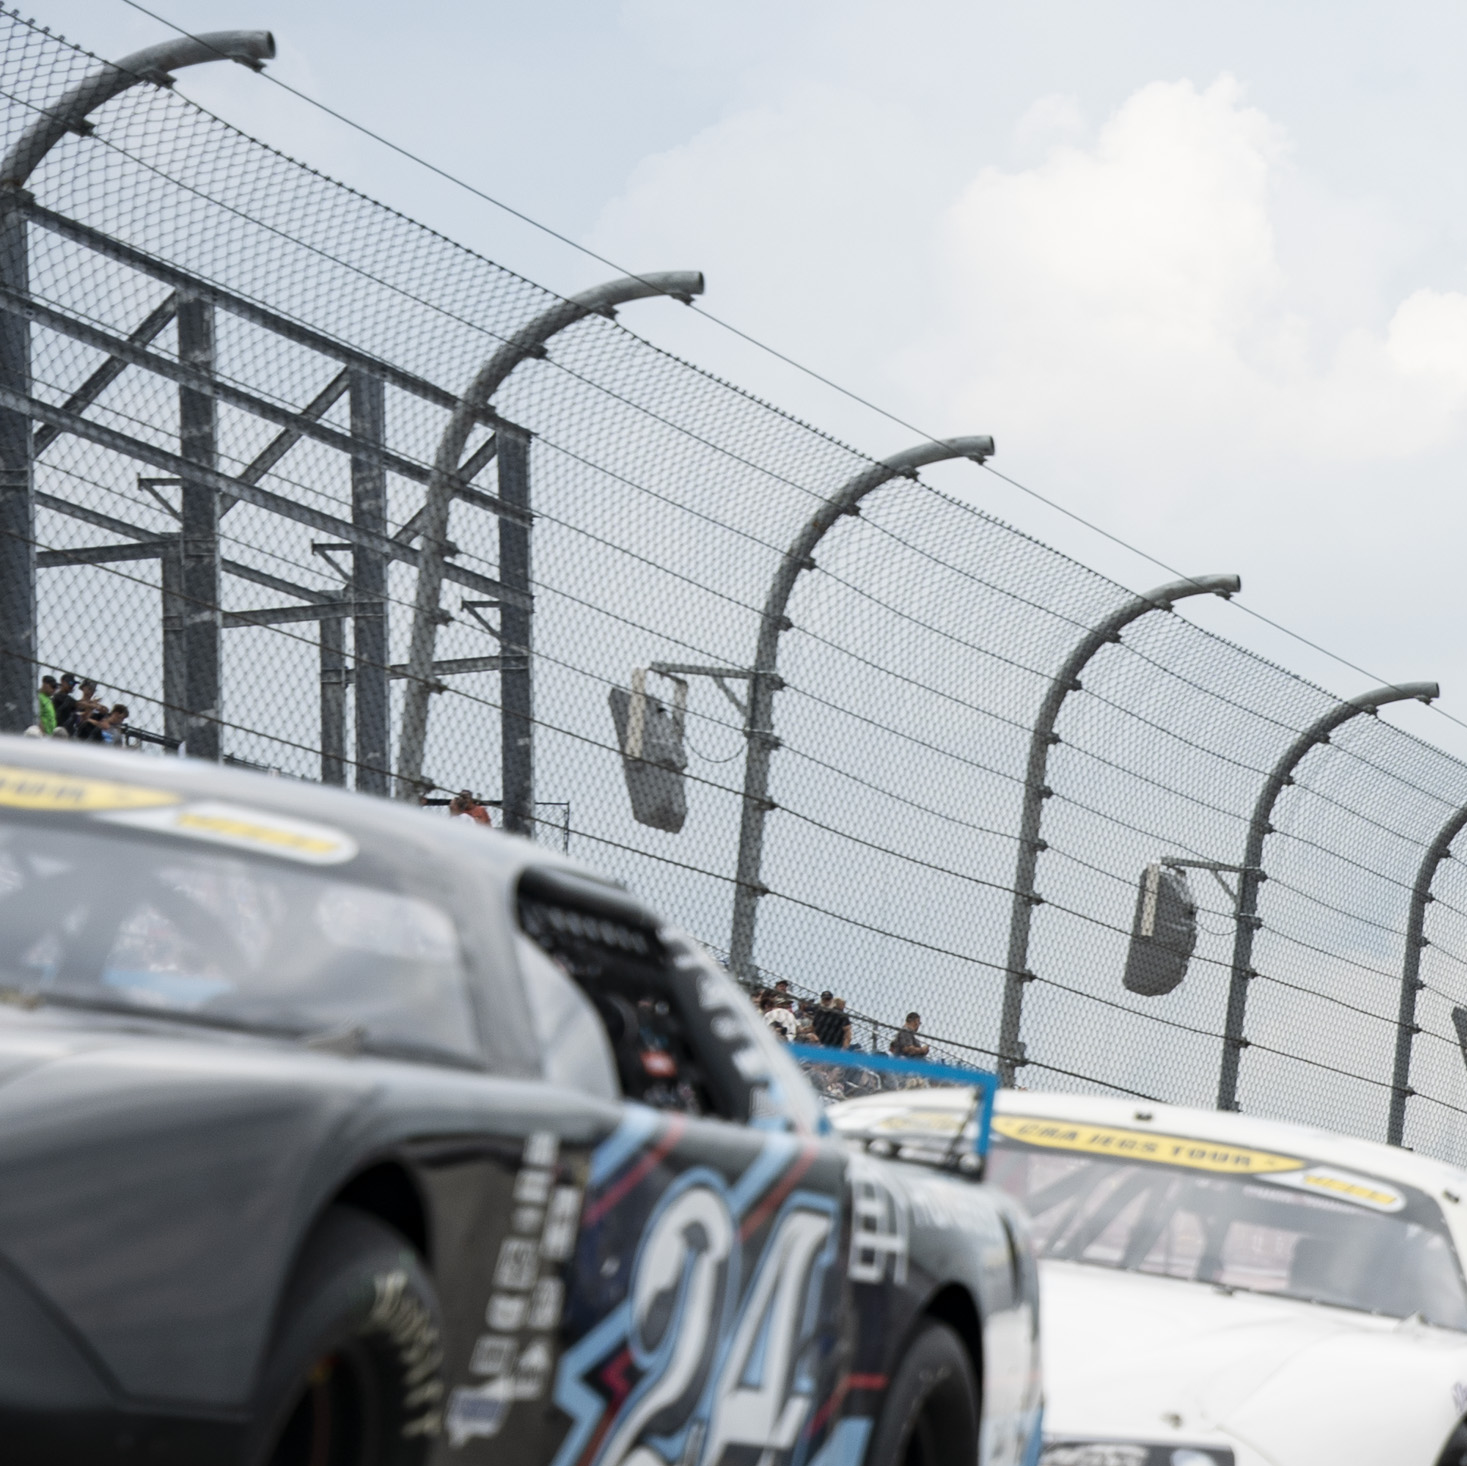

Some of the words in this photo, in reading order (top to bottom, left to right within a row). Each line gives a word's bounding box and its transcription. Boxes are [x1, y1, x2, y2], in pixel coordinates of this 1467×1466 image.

[1018, 1123, 1080, 1142] CRA
[1086, 1134, 1158, 1153] JEGS
[1171, 1146, 1254, 1168] TOUR
